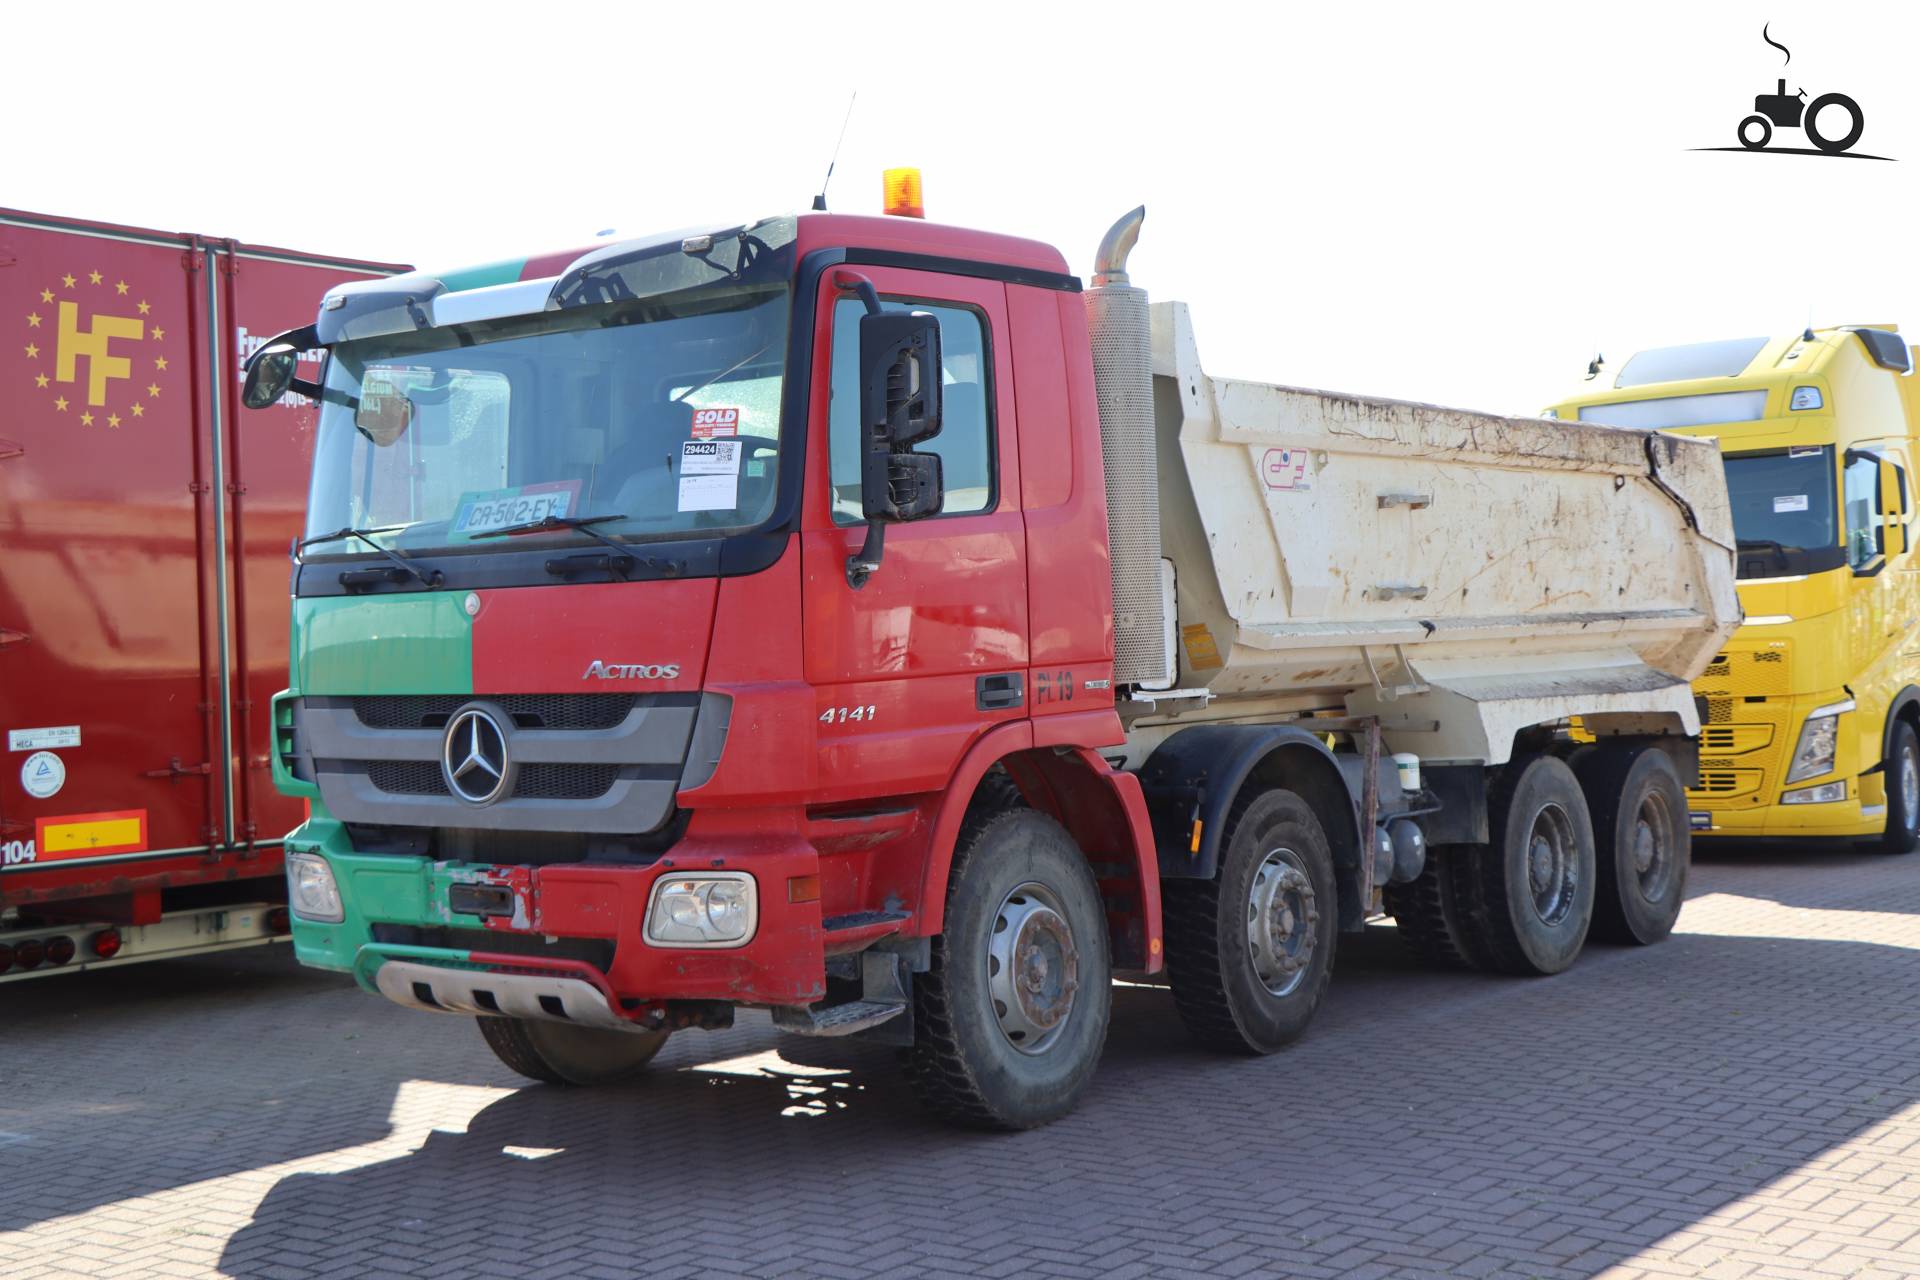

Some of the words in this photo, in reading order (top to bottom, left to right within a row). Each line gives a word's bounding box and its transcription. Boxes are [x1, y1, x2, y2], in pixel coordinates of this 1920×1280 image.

[695, 410, 736, 424] SOLD
[685, 445, 716, 455] 294424
[819, 705, 876, 723] 4141
[0, 840, 36, 864] 104
